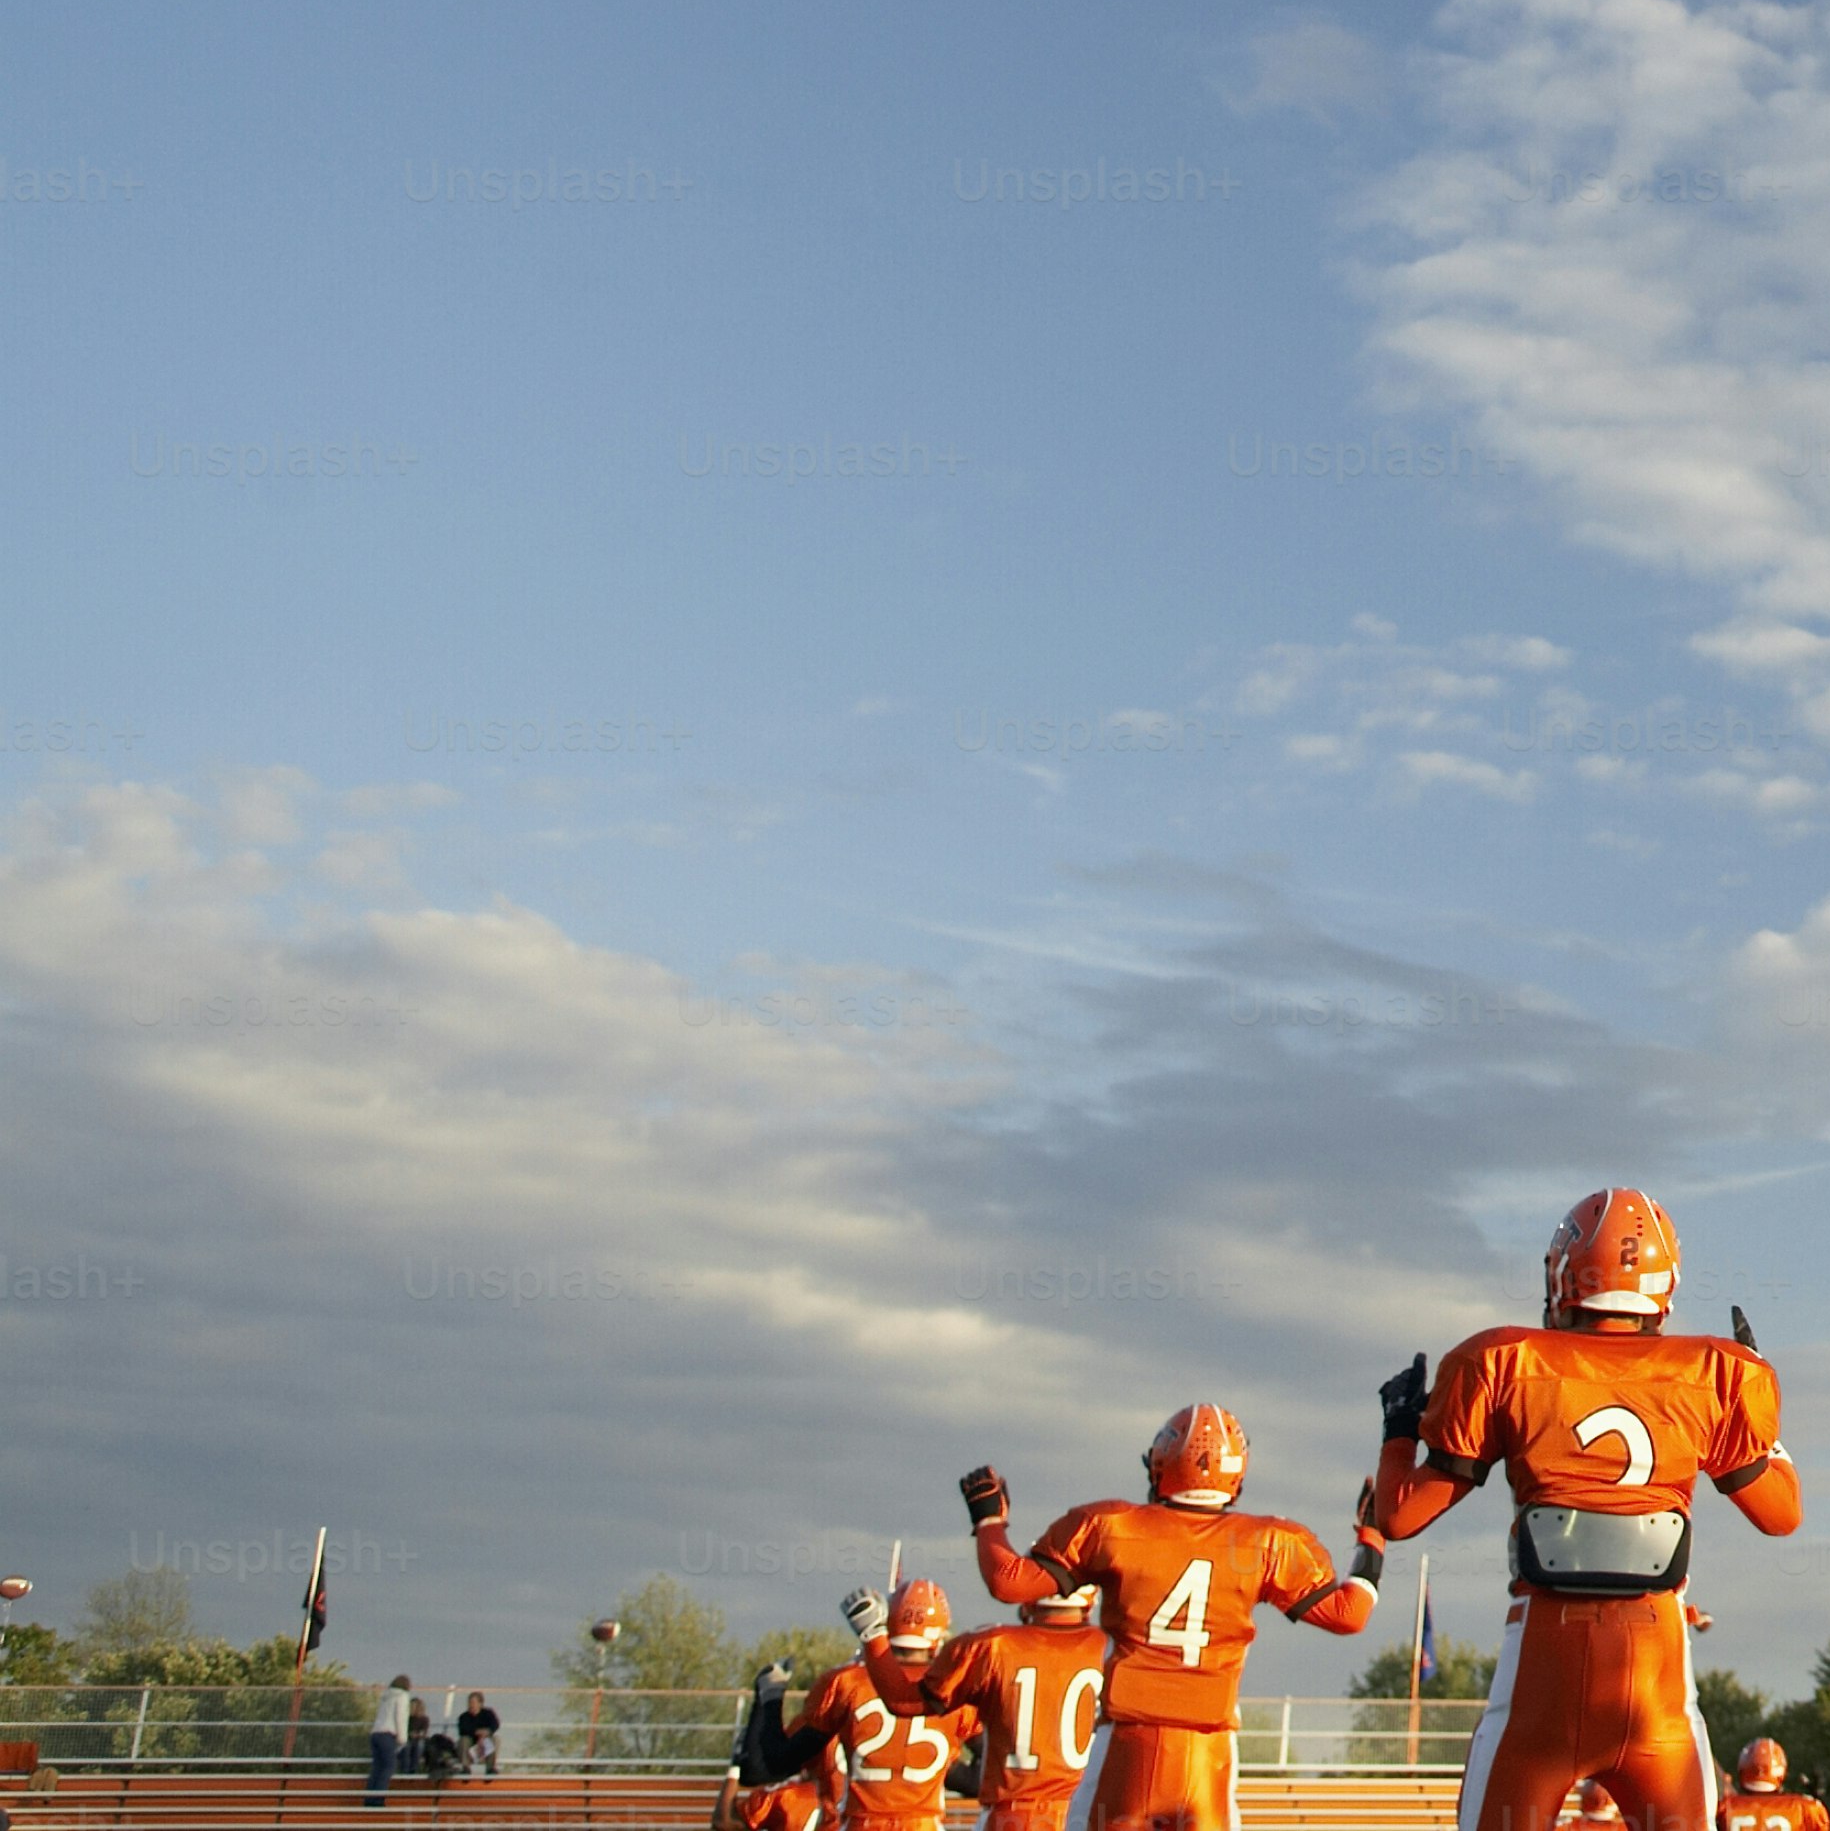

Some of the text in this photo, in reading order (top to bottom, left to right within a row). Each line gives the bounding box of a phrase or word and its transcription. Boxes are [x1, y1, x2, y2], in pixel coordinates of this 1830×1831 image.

[1621, 1238, 1638, 1266] 2
[1145, 1558, 1214, 1668] 4
[852, 1697, 950, 1784] 25
[1005, 1666, 1104, 1771] 10
